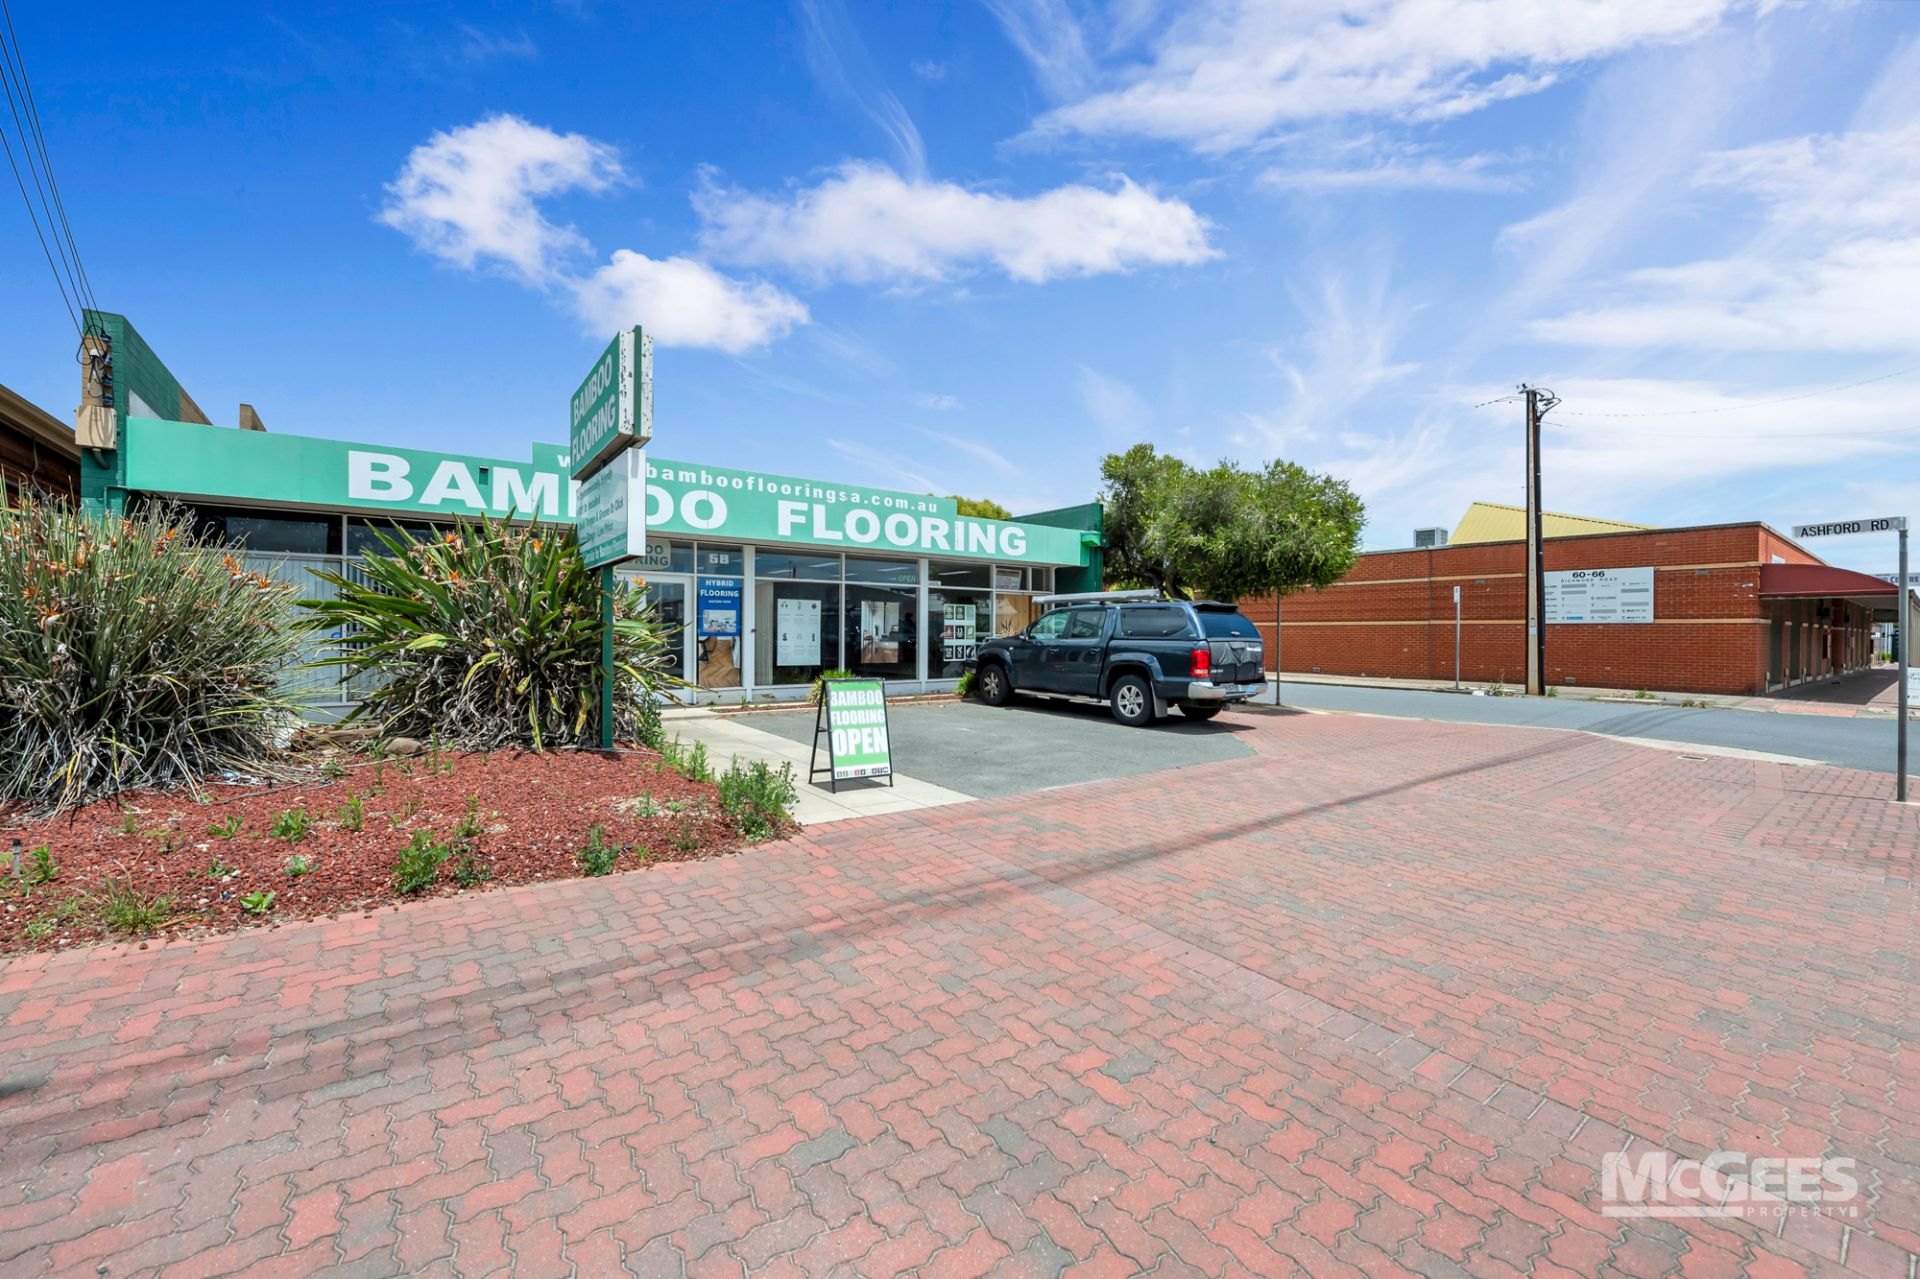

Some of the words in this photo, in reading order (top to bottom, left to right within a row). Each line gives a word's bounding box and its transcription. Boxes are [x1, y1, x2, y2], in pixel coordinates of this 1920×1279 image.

[574, 354, 613, 427] BAMBOO
[572, 394, 616, 467] FLOORING
[557, 454, 938, 513] wbambooflooringsa.com.au
[348, 450, 728, 530] BAMOO
[777, 499, 1027, 556] FLOORING
[1800, 523, 1861, 538] ASHFORD
[1871, 519, 1889, 531] RD
[705, 579, 734, 587] HYBRID
[1572, 570, 1606, 579] 60-66
[700, 589, 739, 598] FLOORING
[830, 690, 884, 707] BAMBOO
[831, 709, 886, 726] FLOORING
[832, 727, 888, 757] OPEN
